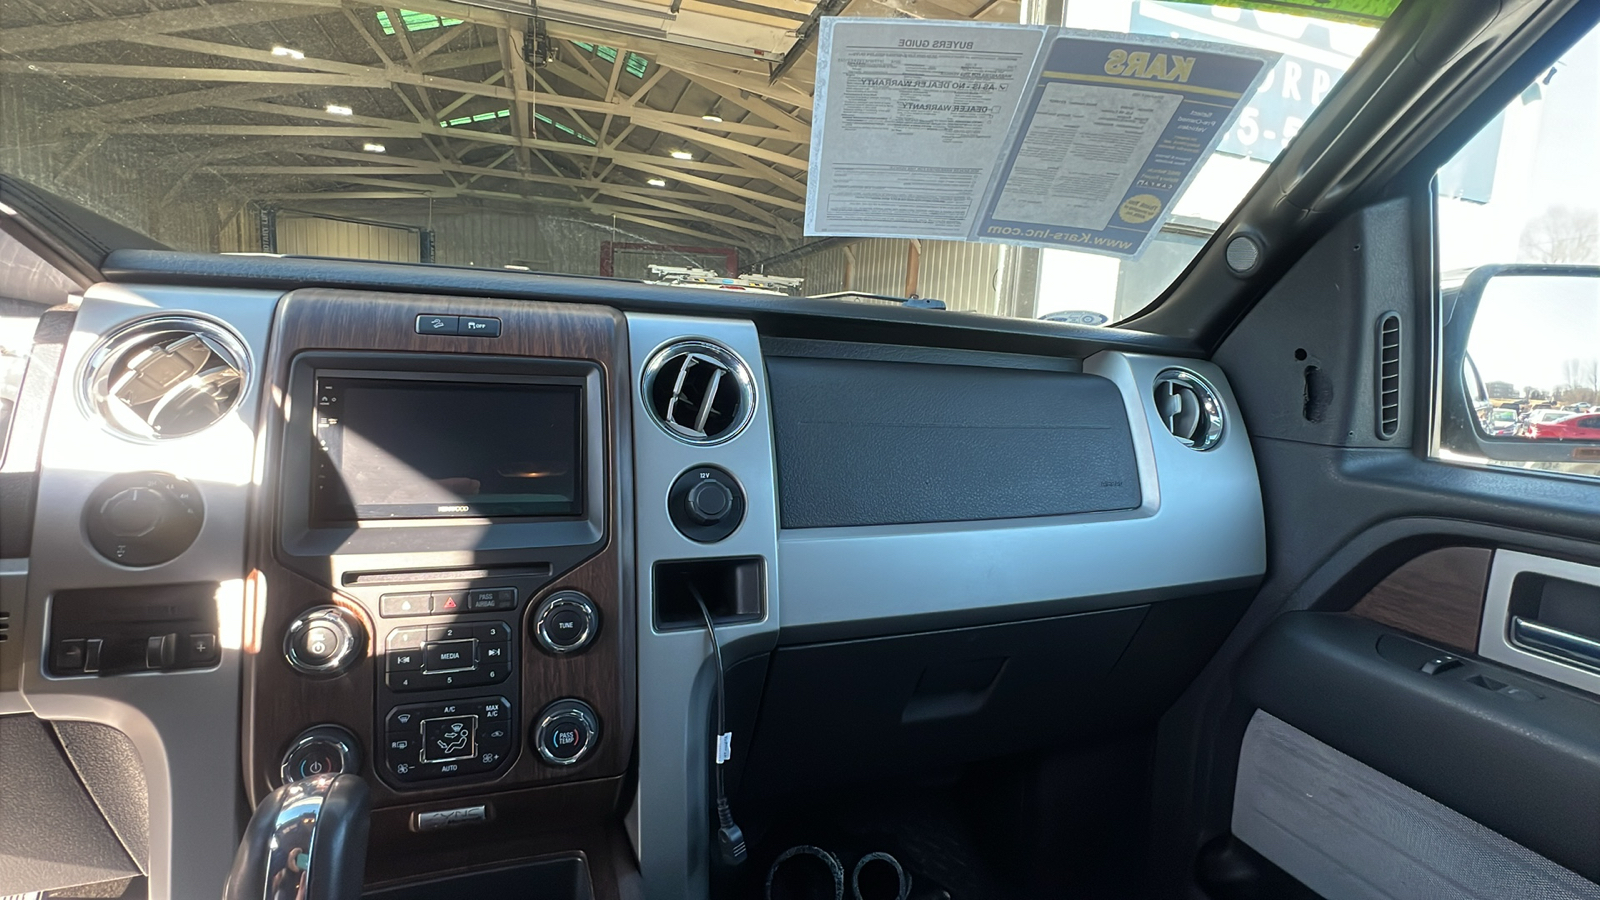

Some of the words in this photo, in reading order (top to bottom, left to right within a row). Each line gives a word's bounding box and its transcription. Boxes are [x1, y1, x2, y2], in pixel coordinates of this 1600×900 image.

[1223, 106, 1303, 149] 5-5
[261, 209, 270, 225] LIFT
[440, 652, 460, 660] MEDIA
